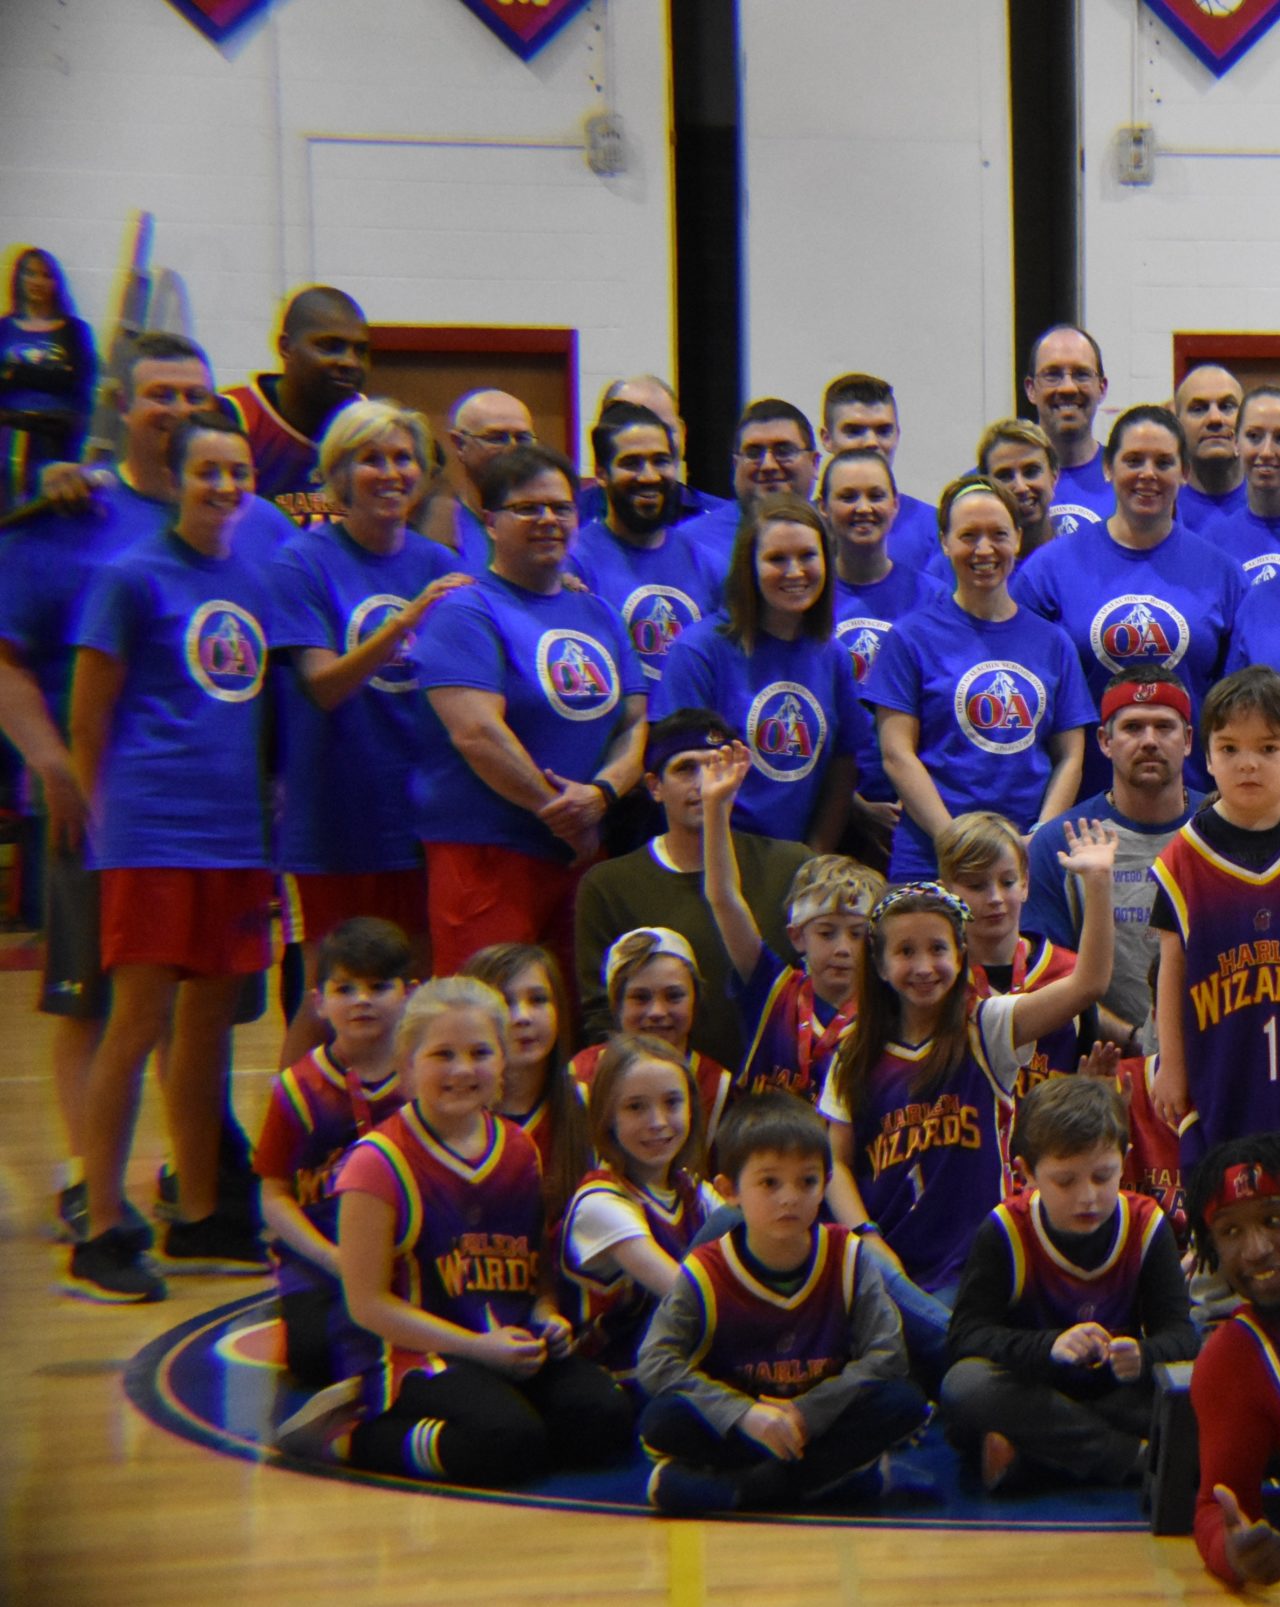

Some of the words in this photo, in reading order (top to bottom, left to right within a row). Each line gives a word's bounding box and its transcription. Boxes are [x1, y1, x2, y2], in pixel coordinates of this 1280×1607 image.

[199, 635, 257, 677] OA
[1103, 622, 1173, 657] OA
[551, 661, 612, 696] OA
[967, 692, 1034, 729] OA
[755, 717, 812, 757] OA
[1263, 1016, 1277, 1082] 1
